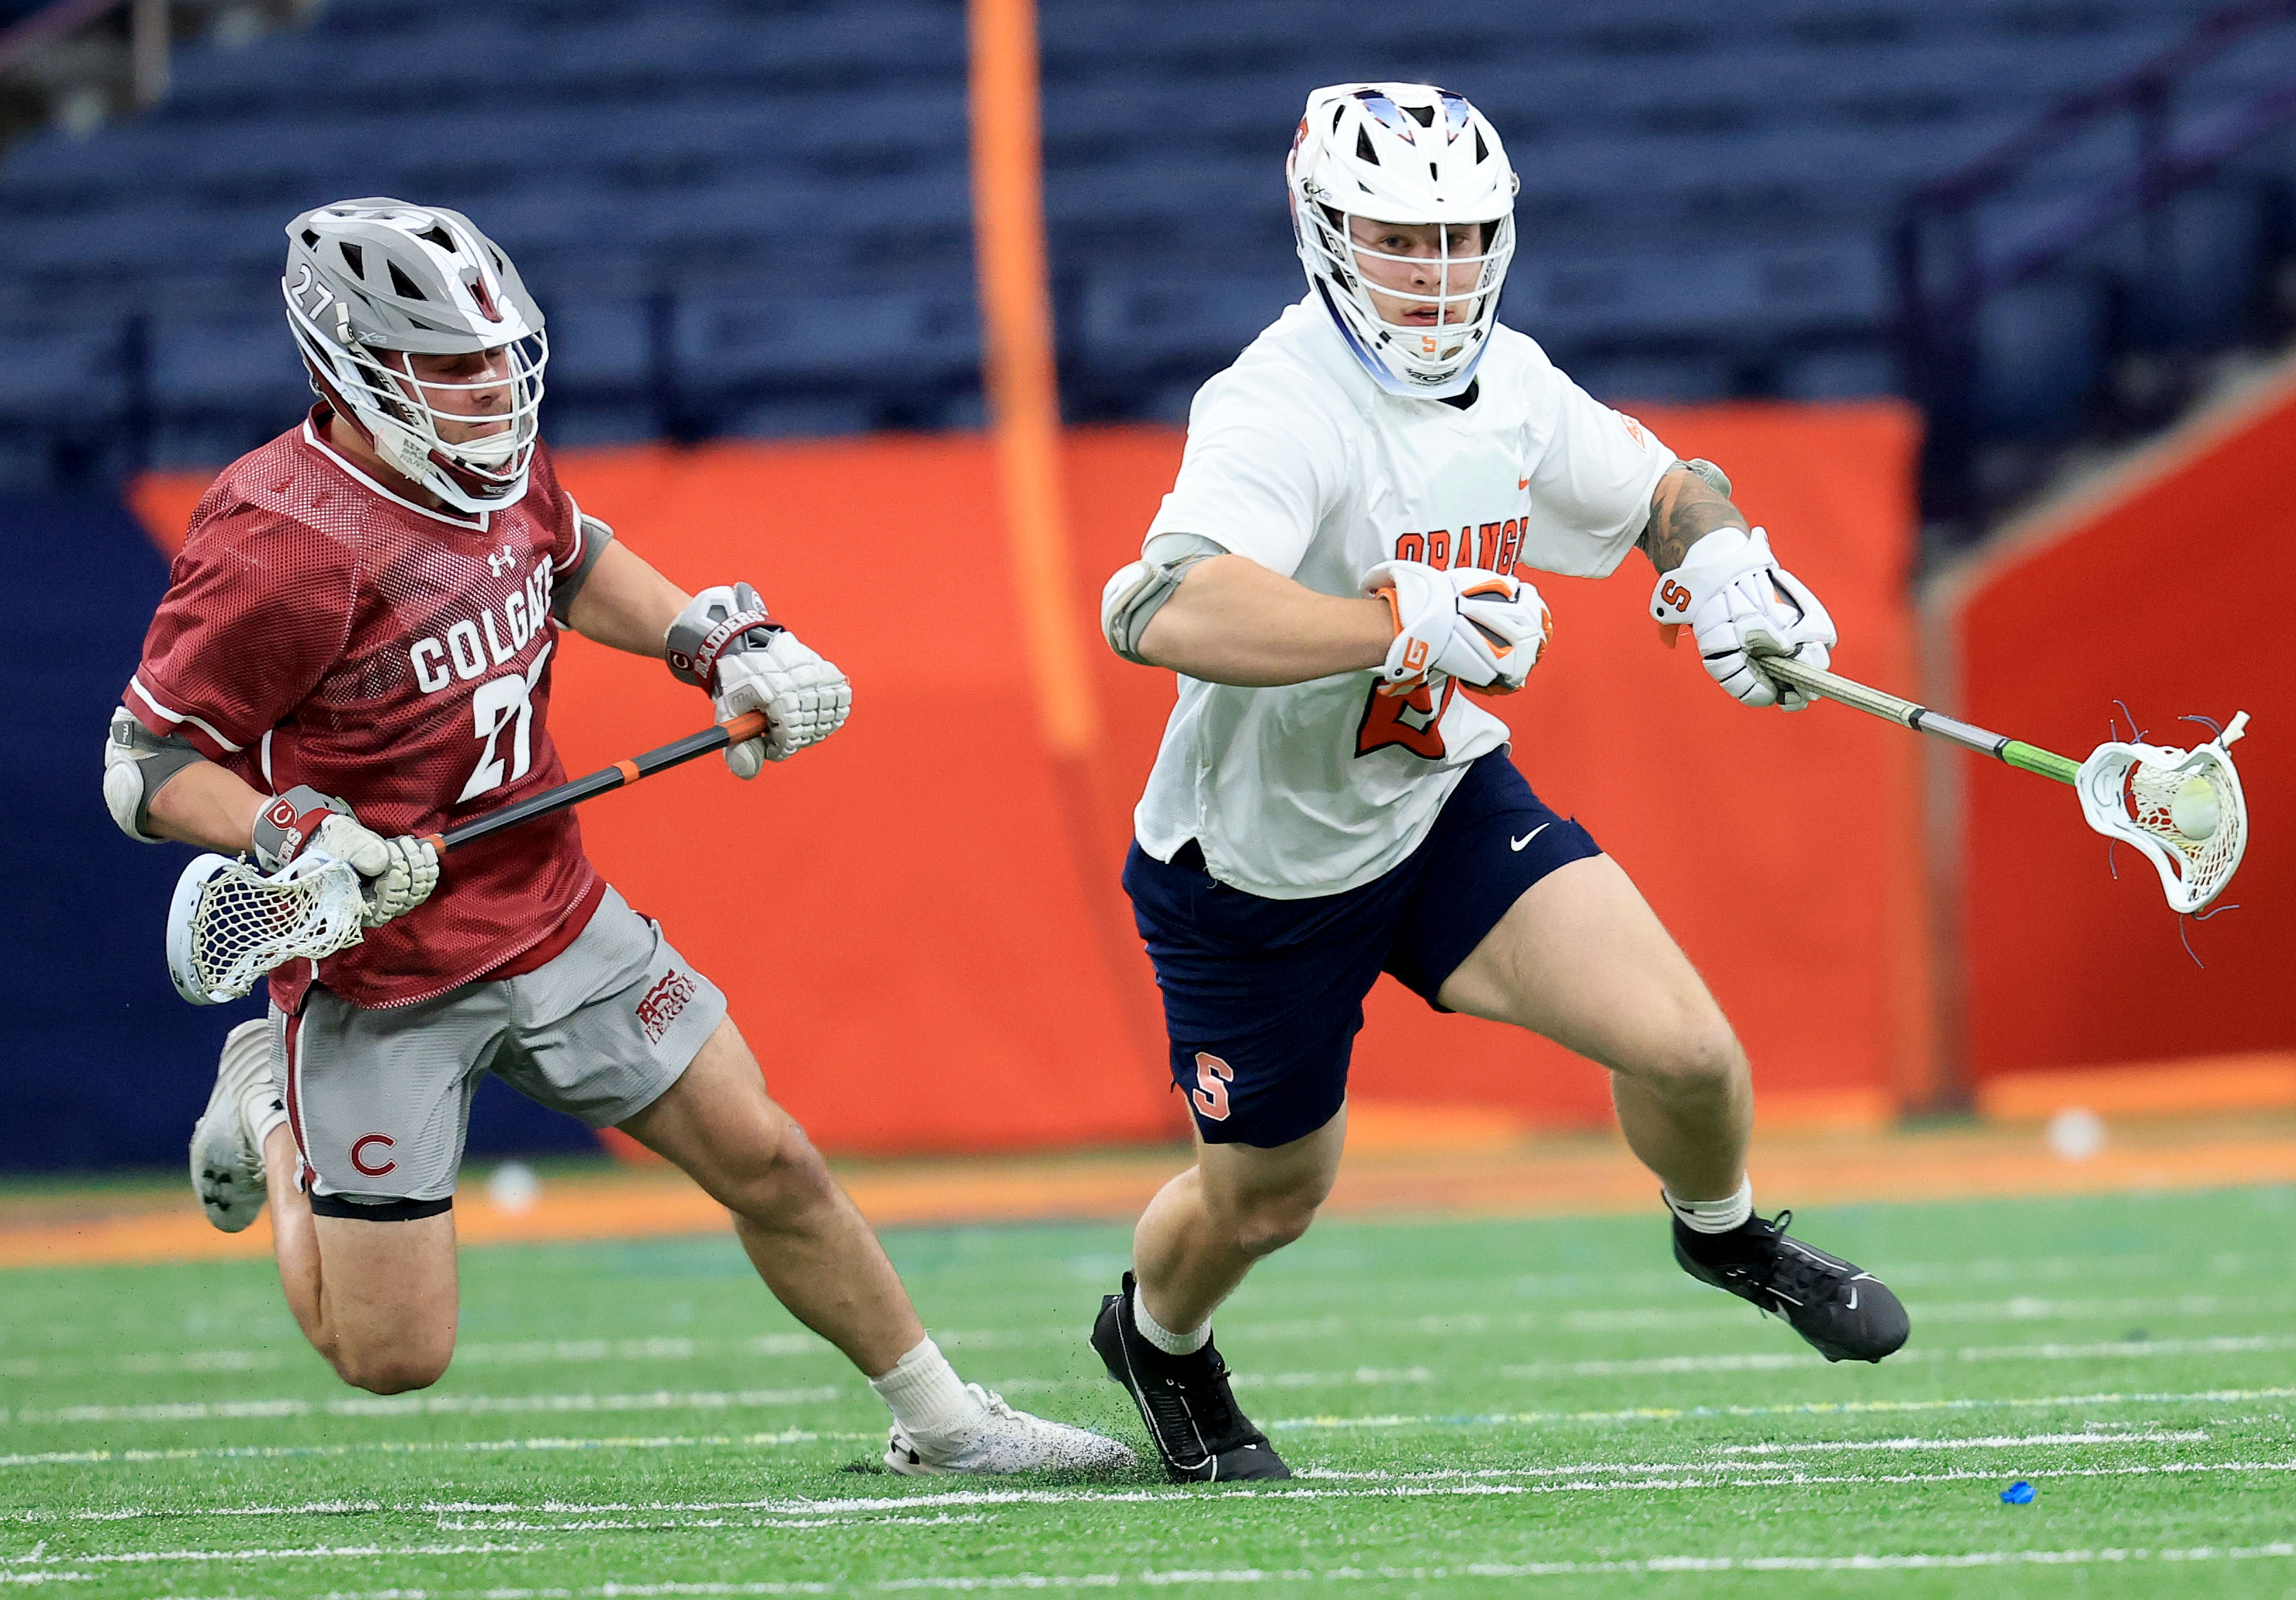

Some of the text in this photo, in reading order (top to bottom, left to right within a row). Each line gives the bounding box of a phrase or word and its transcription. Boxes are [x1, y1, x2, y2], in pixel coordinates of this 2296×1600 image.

[291, 263, 335, 321] 27
[410, 554, 553, 694] COLGATE
[1661, 579, 1691, 612] S
[673, 654, 689, 669] C
[694, 609, 765, 678] RAIDERS
[273, 805, 292, 824] C
[649, 981, 697, 1045] LEAGUE
[1193, 1052, 1234, 1121] S
[349, 1133, 399, 1178] C
